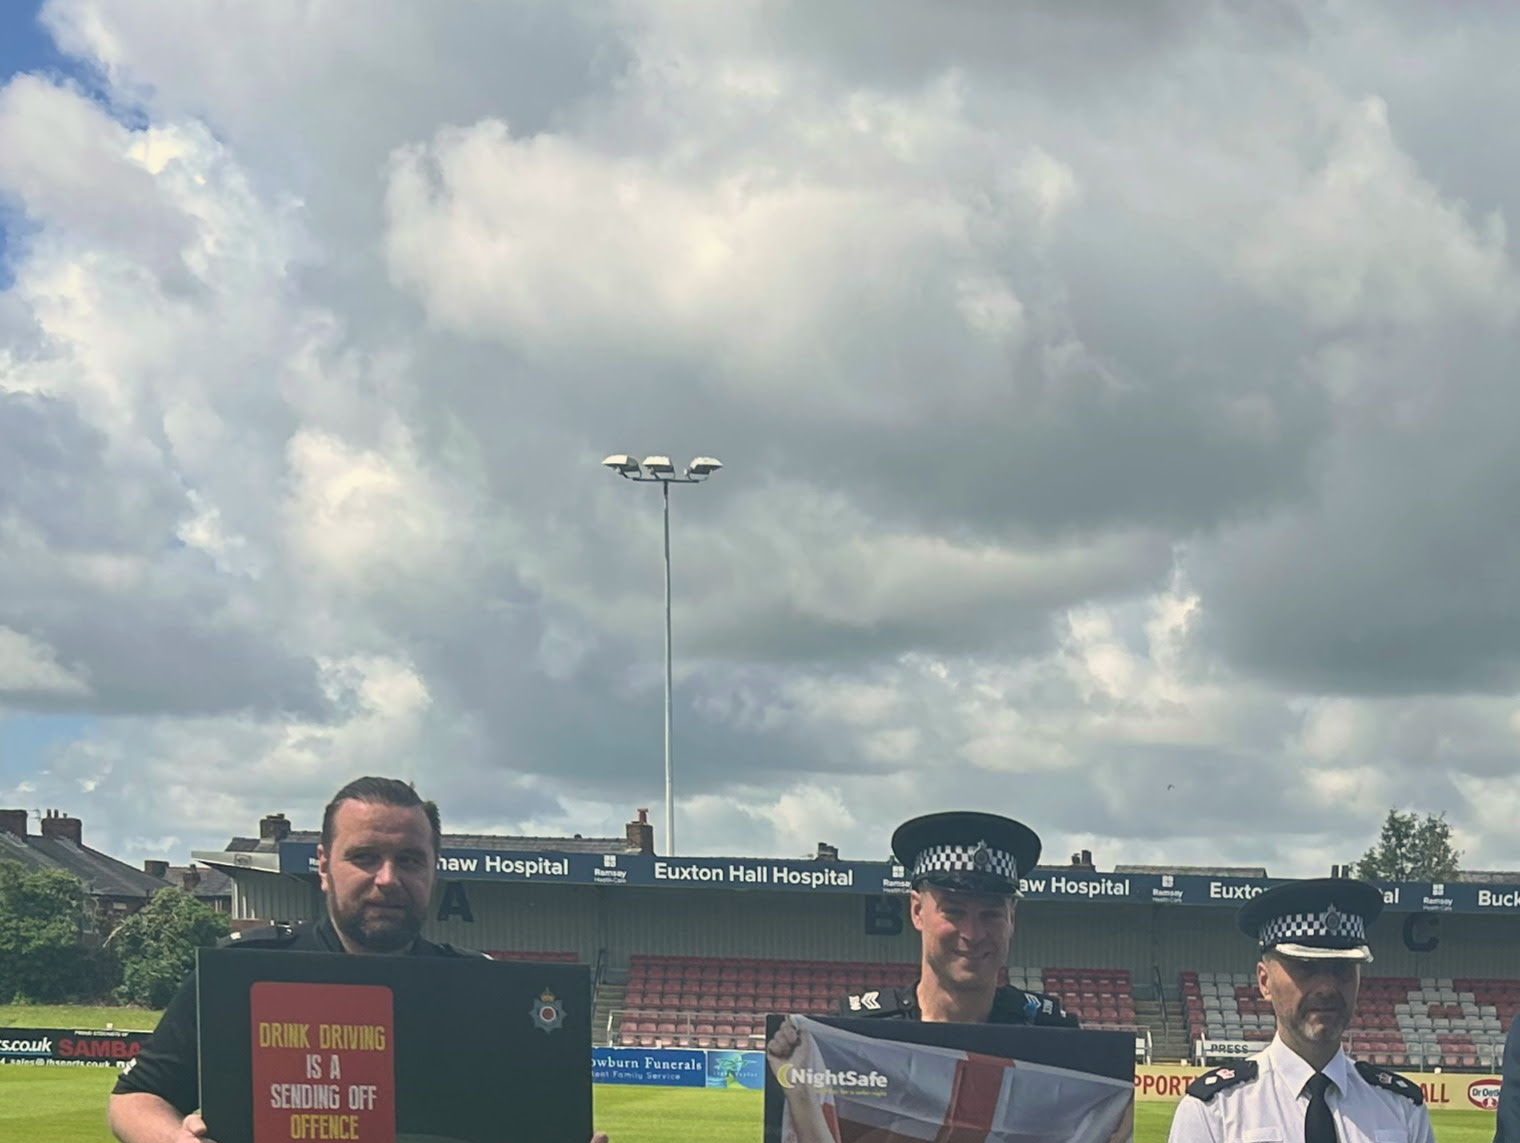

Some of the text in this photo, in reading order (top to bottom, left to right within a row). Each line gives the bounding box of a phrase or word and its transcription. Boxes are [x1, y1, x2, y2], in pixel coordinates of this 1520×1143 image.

[486, 856, 568, 878] Hospital
[594, 868, 626, 878] Ramsay
[655, 862, 853, 888] Euxton Hall Hospital
[1051, 877, 1129, 898] Hospital
[1211, 882, 1268, 899] Euxto
[438, 881, 473, 922] A
[1403, 912, 1439, 951] C
[259, 1022, 386, 1050] DRINK DRIVING
[58, 1038, 142, 1058] SAMBA
[1211, 1044, 1248, 1053] PRESS
[306, 1054, 340, 1079] IS A
[645, 1057, 702, 1070] Funerals
[790, 1068, 888, 1088] NightSafe
[271, 1084, 377, 1110] SENDING OFF
[290, 1114, 359, 1139] OFFENCE
